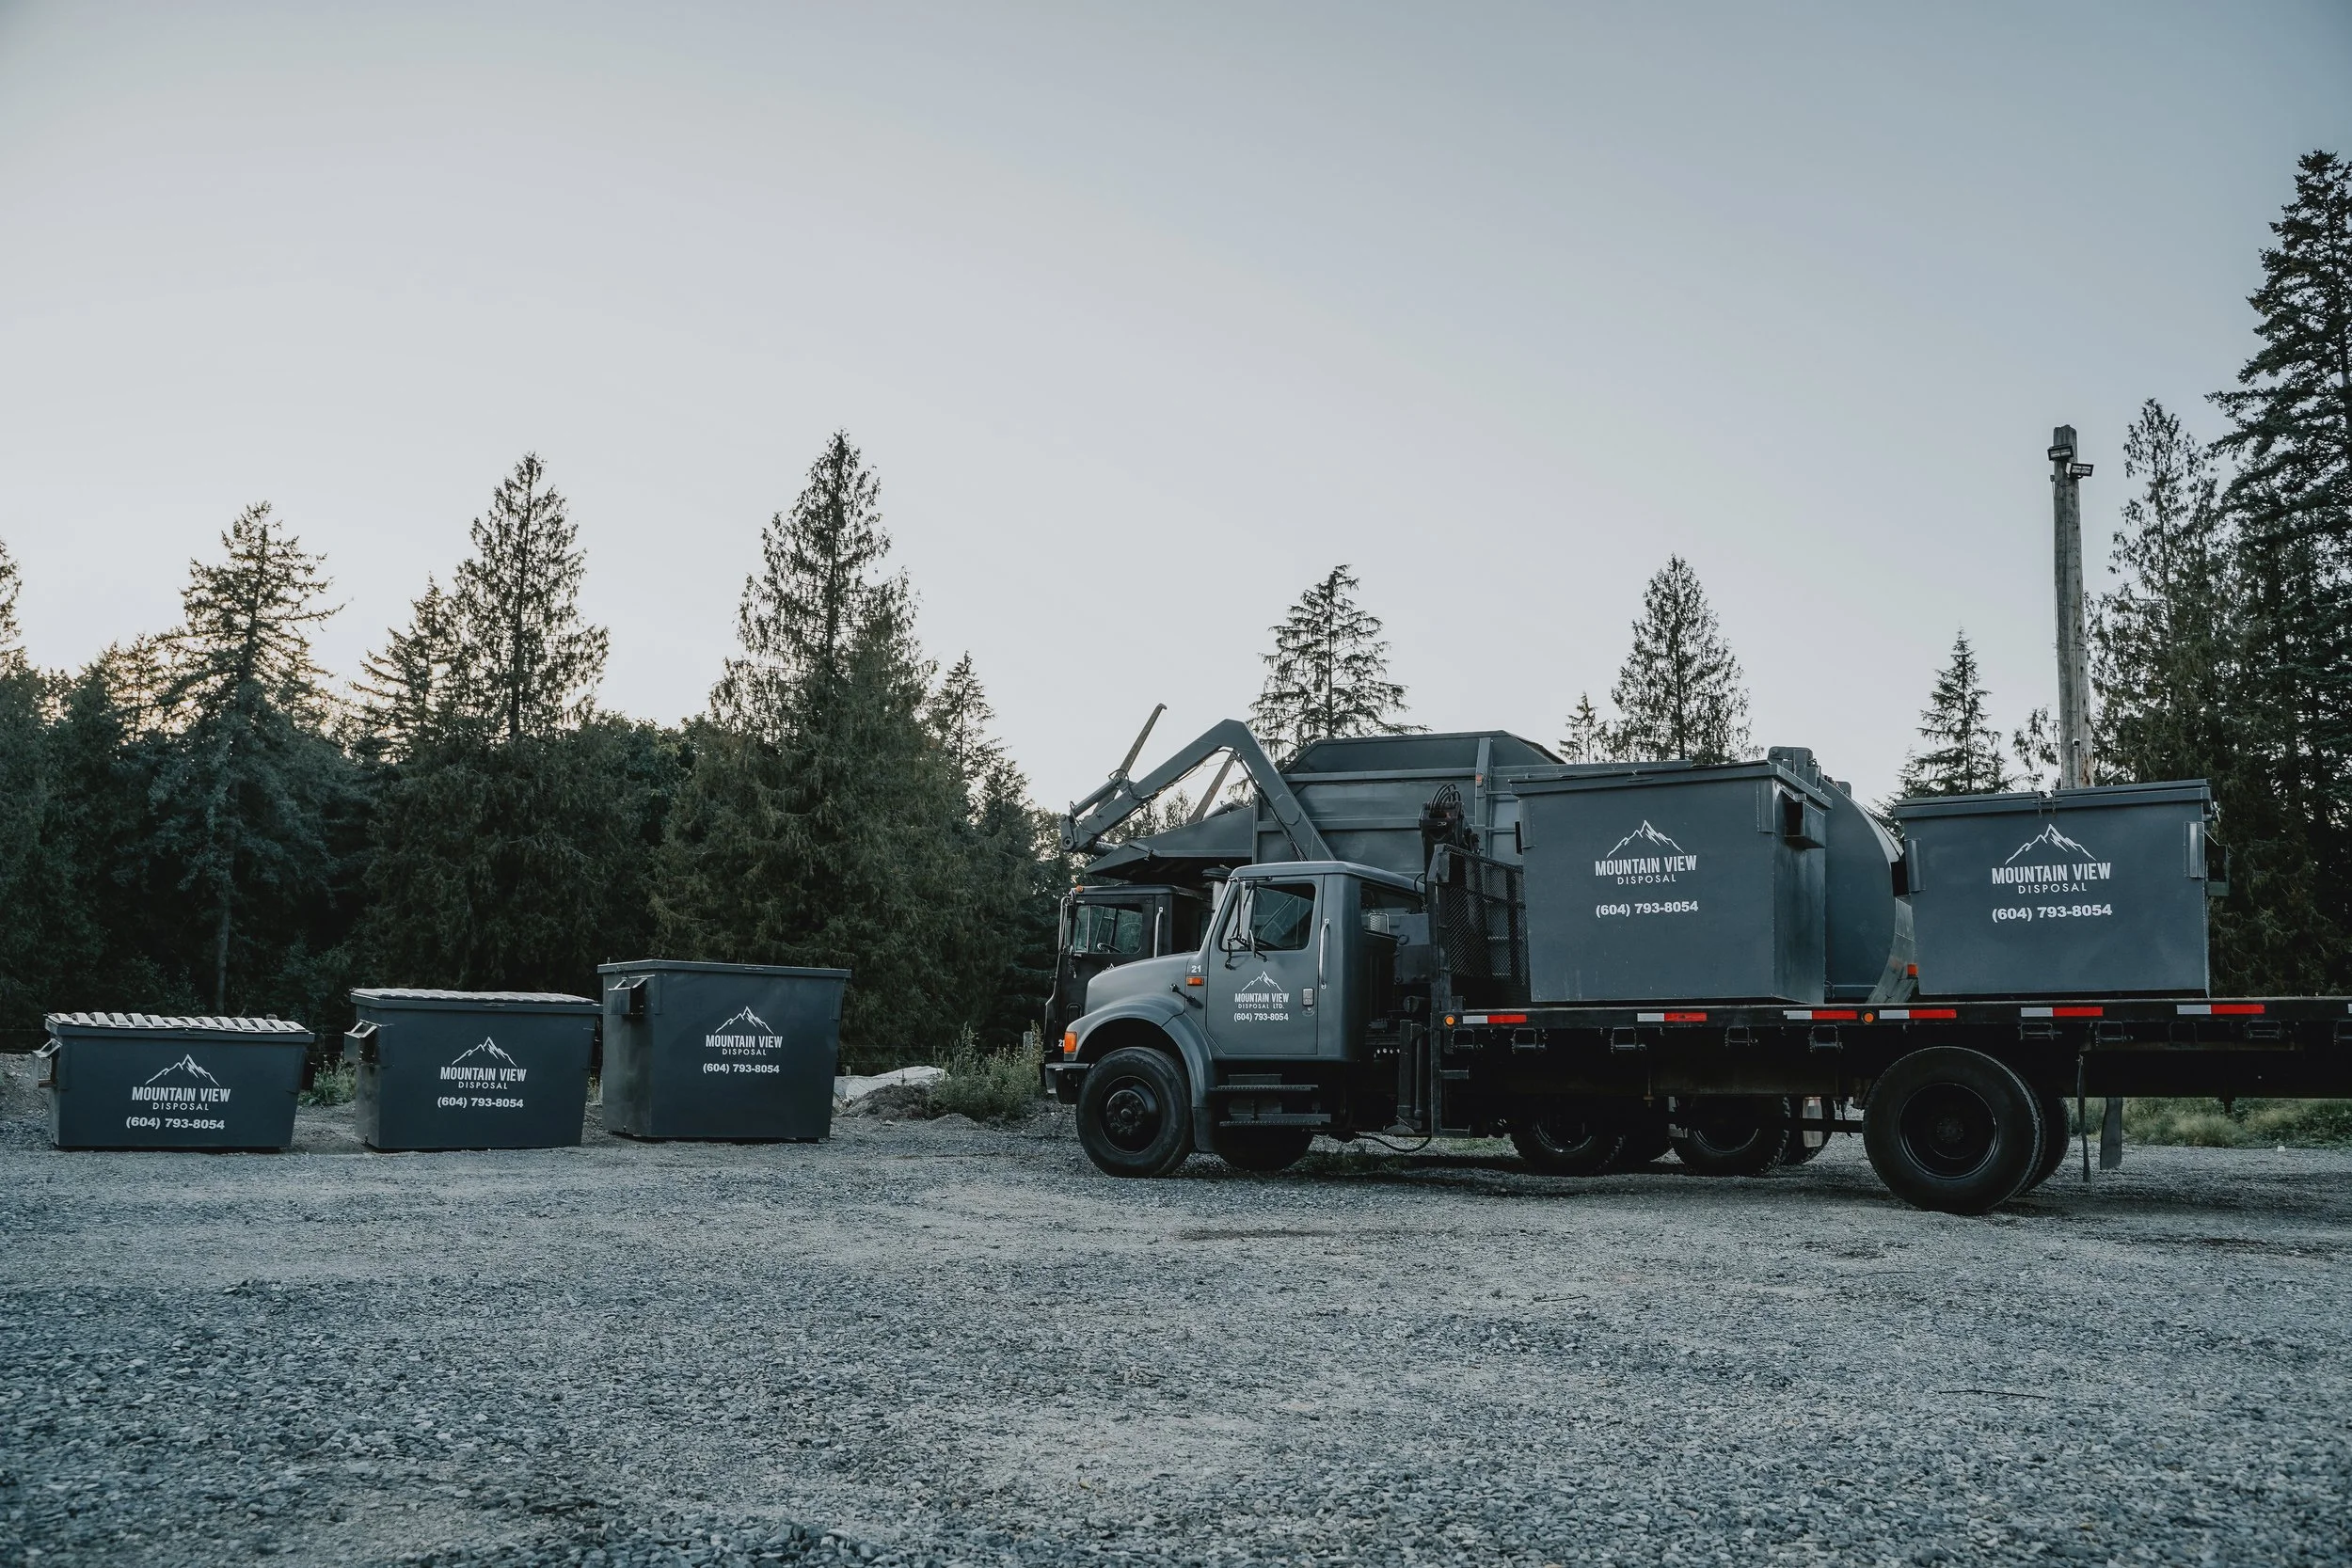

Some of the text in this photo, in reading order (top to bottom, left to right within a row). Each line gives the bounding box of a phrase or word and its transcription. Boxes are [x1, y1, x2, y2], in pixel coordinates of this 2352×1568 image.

[1595, 854, 1697, 877] MOUNTAIN VIEW
[1616, 873, 1677, 885] DISPOSAL
[1991, 862, 2111, 885] MOUNTAIN VIEW
[2017, 881, 2088, 895] DISPOSAL
[1595, 900, 1699, 919] (604) 793-8054
[1992, 903, 2113, 924] (604) 793-8054
[1191, 964, 1201, 974] 21
[1234, 992, 1290, 1004] MOUNTAIN VIEW
[1233, 1012, 1290, 1022] (604) 793-8054
[705, 1034, 784, 1049] MOUNTAIN VIEW
[722, 1048, 767, 1056] DISPOSAL
[439, 1066, 528, 1083] MOUNTAIN VIEW
[702, 1062, 781, 1075] (604) 793-8054
[457, 1081, 508, 1090] DISPOSAL
[131, 1085, 231, 1102] MOUNTAIN VIEW
[151, 1101, 210, 1111] DISPOSAL
[437, 1096, 524, 1109] (604) 793-8054
[125, 1116, 226, 1130] (604) 793-8054
